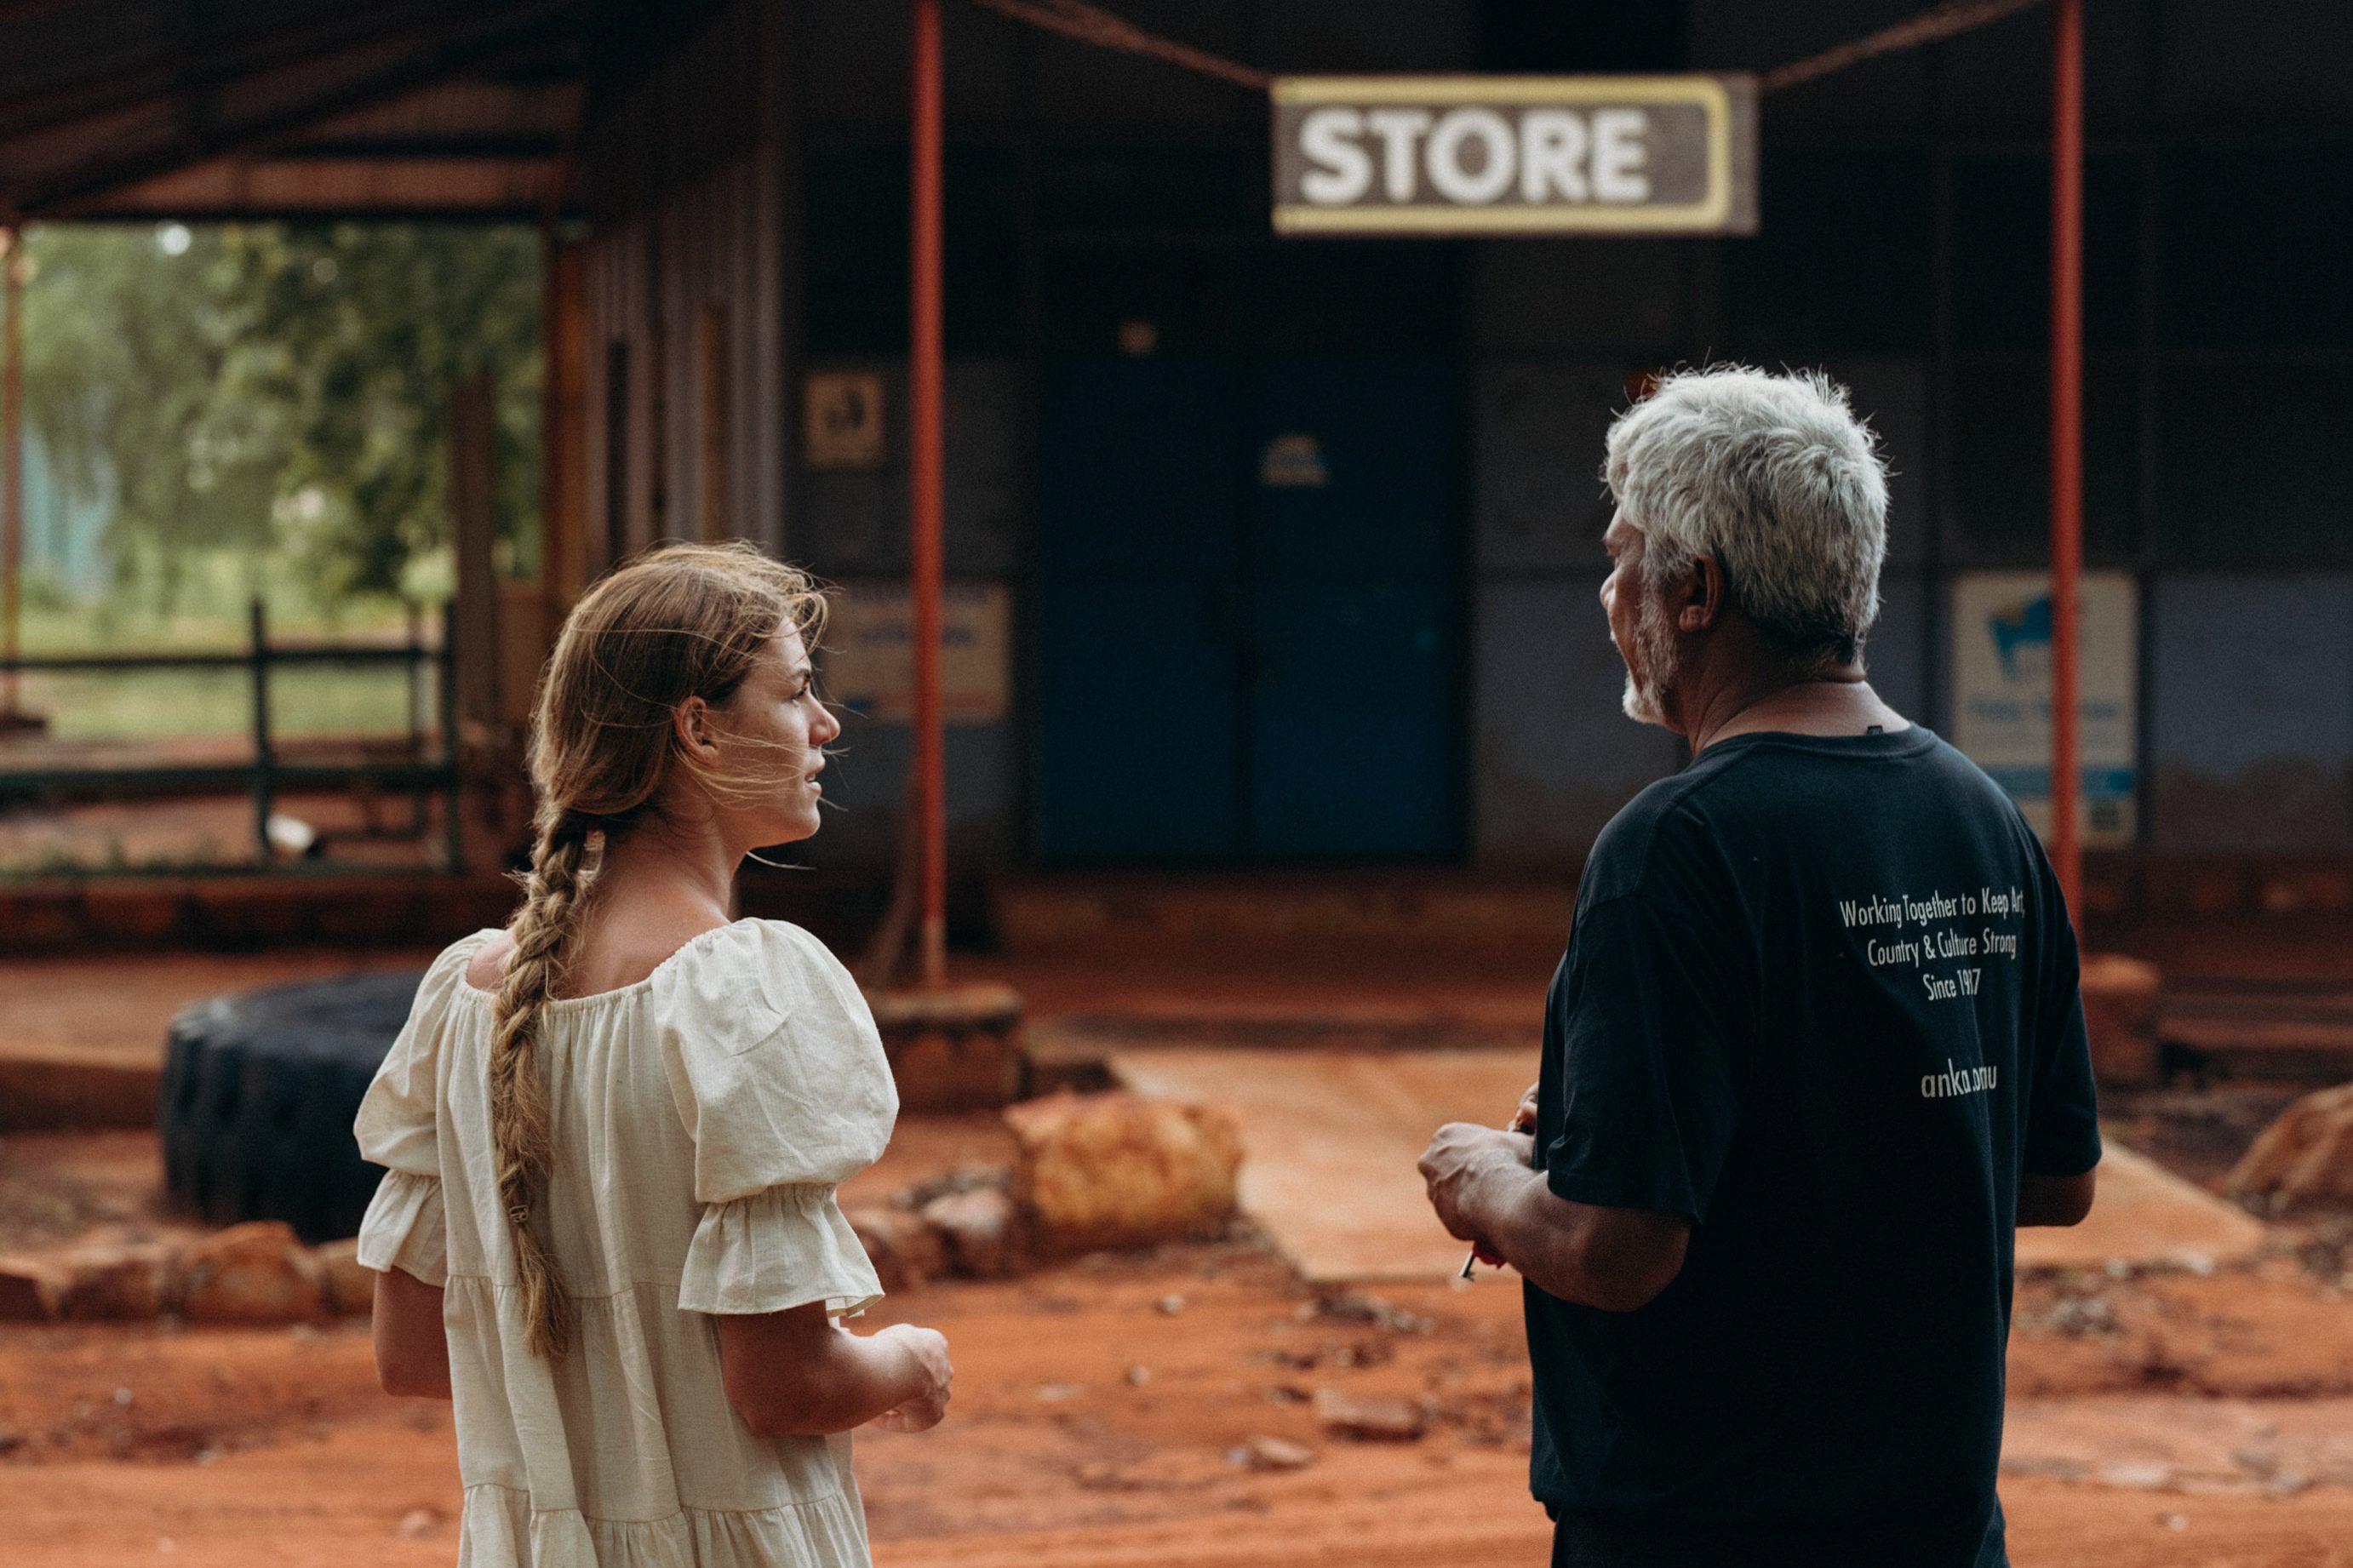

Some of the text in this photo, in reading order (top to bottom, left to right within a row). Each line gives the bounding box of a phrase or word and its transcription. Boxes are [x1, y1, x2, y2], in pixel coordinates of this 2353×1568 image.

[1298, 107, 1652, 204] STORE
[1840, 885, 2025, 929] Working Together to Keep Art,
[1868, 927, 2017, 968] Country & Culture Strong
[1922, 974, 1956, 1001] Since
